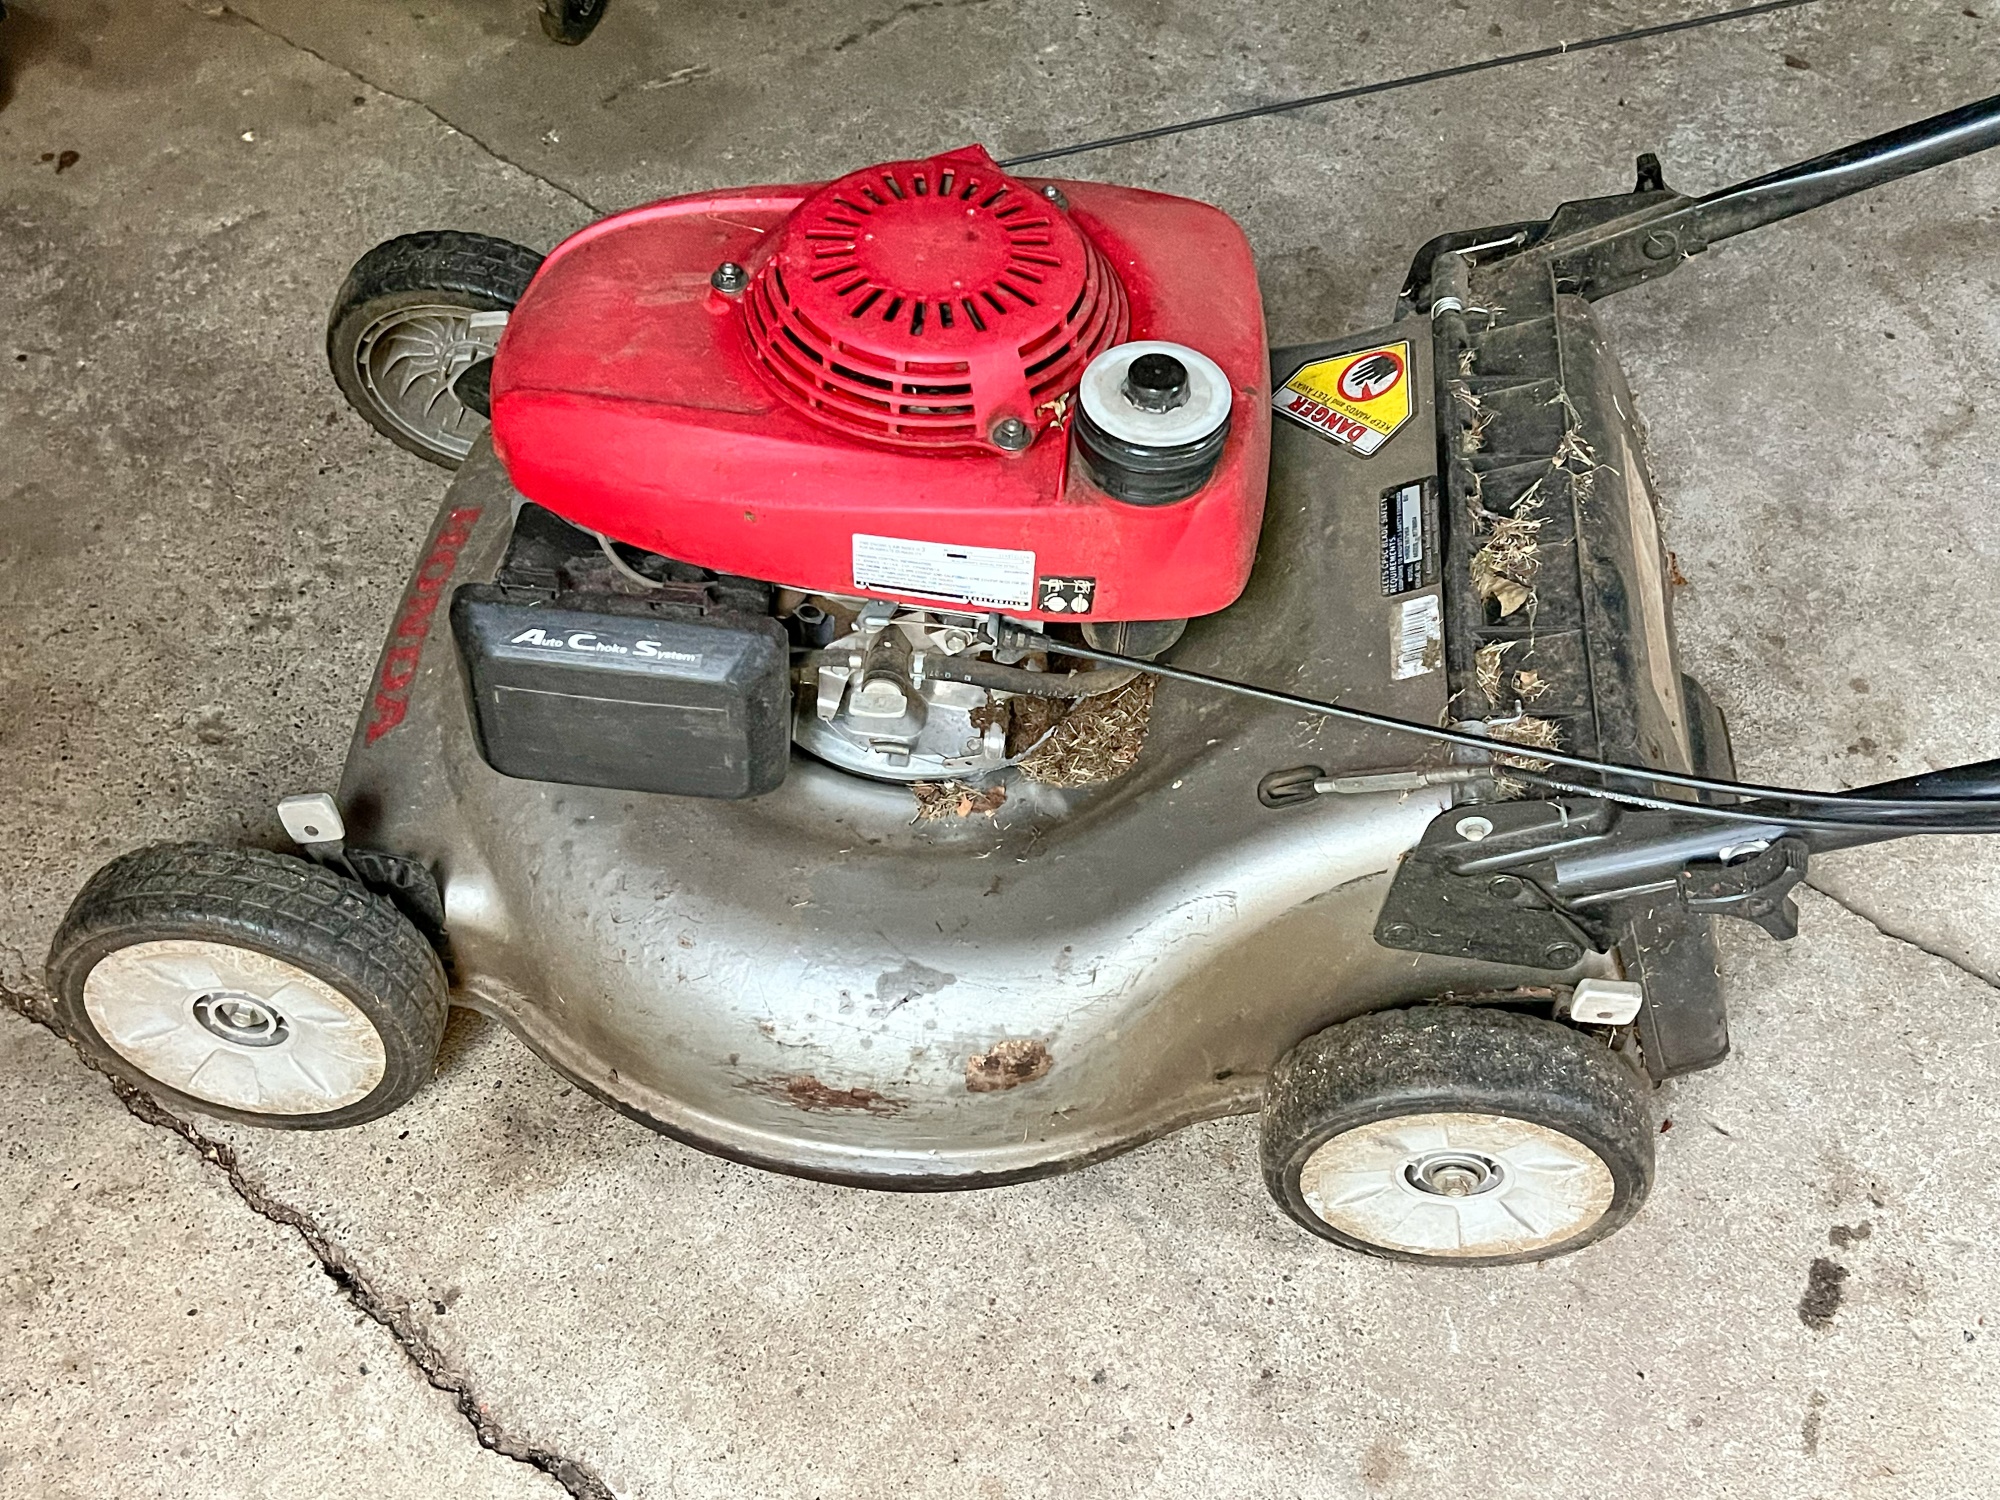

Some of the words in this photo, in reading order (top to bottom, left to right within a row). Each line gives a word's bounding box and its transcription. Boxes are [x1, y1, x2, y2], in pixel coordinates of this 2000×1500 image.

[1291, 380, 1314, 395] AWAY
[1312, 388, 1332, 404] FEET
[1331, 398, 1346, 410] and
[1344, 404, 1372, 422] HANDS
[1287, 395, 1368, 443] DANGER
[1370, 418, 1392, 432] KEEP
[1380, 498, 1388, 524] SAFETY
[1381, 549, 1389, 569] CPSC
[365, 507, 482, 747] HONDA
[511, 628, 564, 648] Auto
[567, 633, 628, 654] Choke
[632, 640, 696, 662] System
